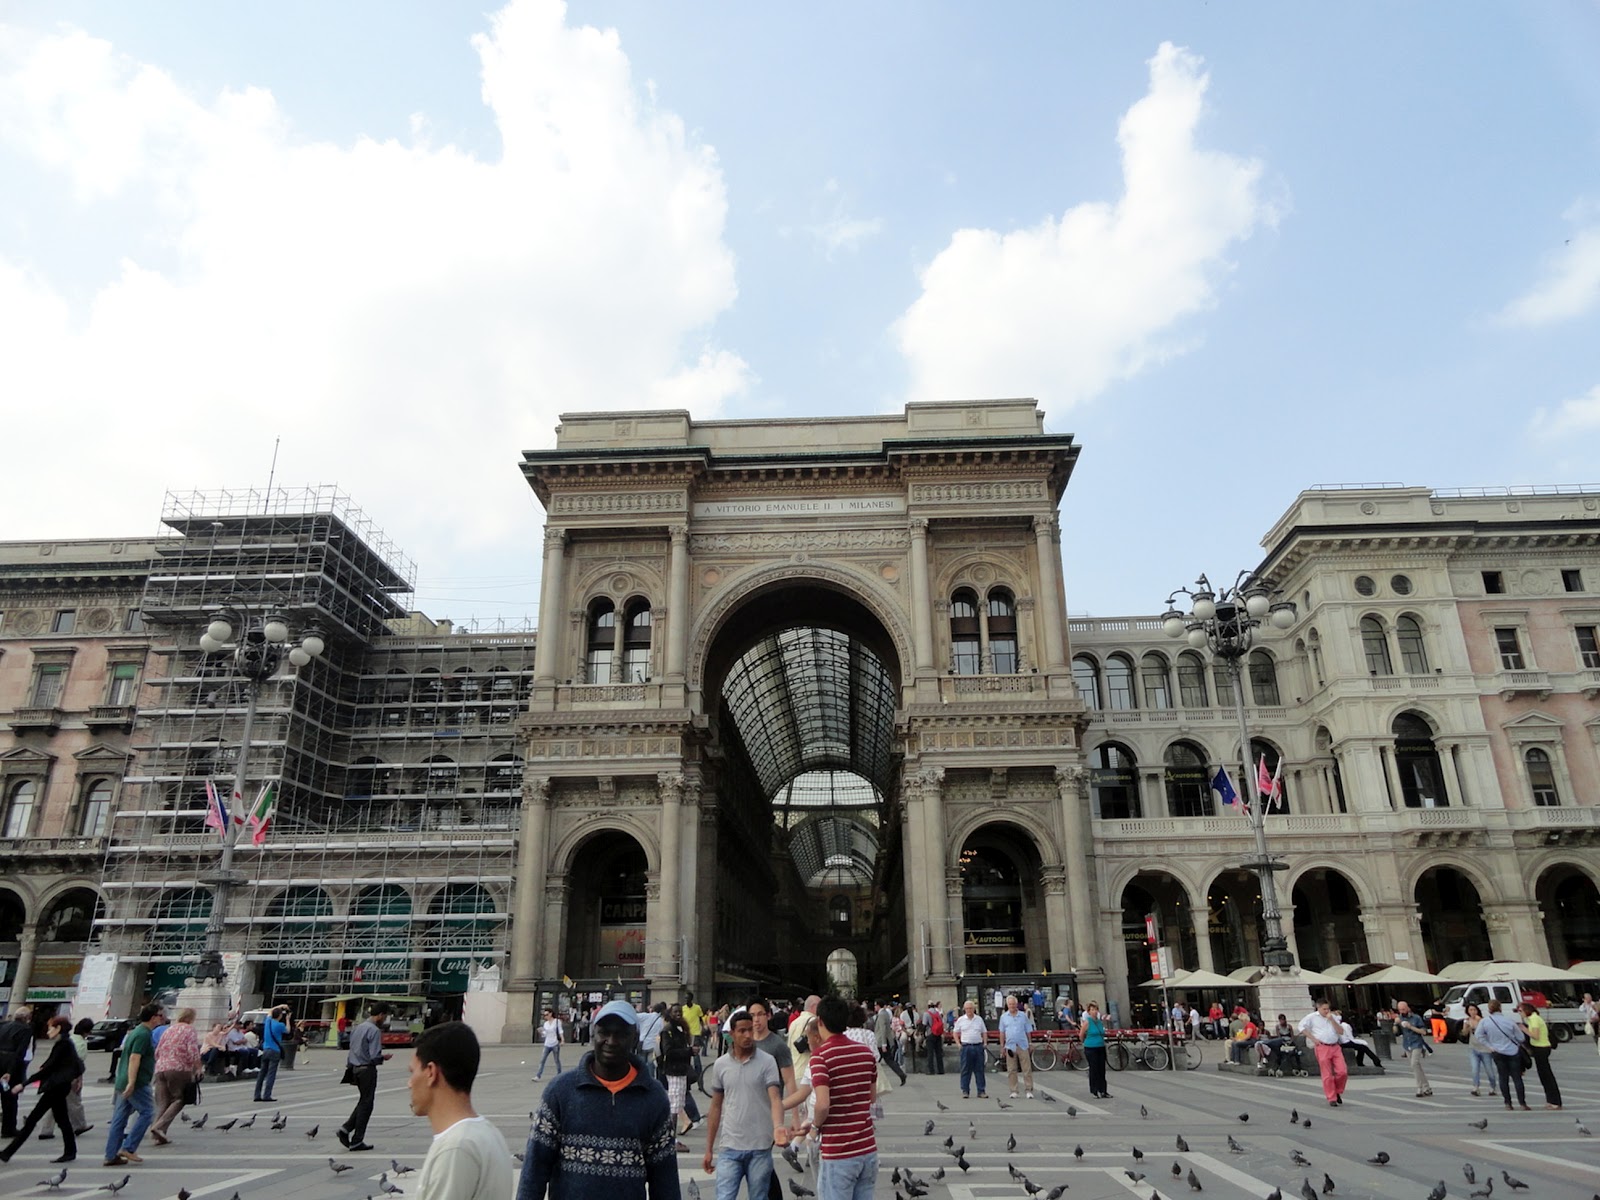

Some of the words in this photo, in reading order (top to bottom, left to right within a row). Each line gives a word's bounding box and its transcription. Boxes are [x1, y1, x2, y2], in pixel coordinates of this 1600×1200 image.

[716, 504, 761, 513] VITTORIO
[766, 503, 819, 512] EMANUELE
[849, 501, 895, 510] MILANESI
[604, 903, 646, 918] CAMPA
[978, 935, 1015, 943] AUTOGRILL
